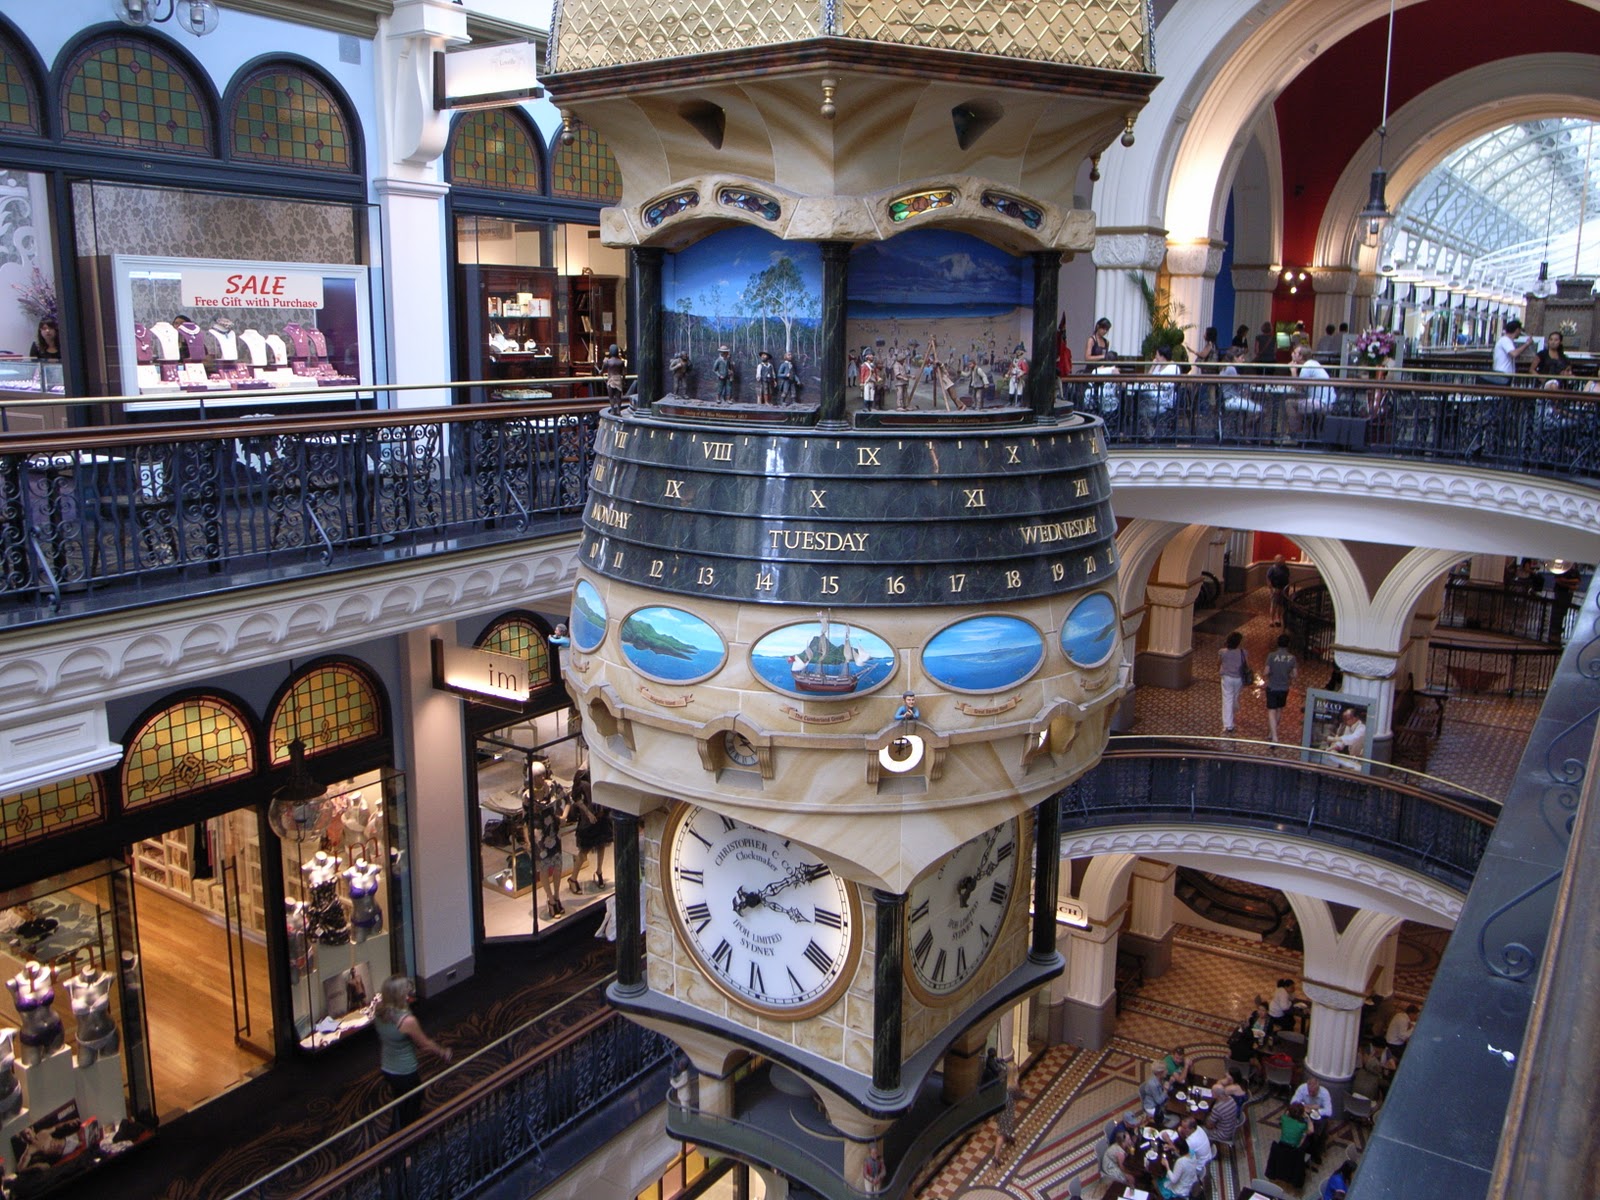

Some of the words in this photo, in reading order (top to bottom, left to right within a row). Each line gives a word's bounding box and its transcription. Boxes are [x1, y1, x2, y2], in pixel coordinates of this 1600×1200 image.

[225, 274, 287, 295] SALE
[194, 296, 218, 307] Free
[221, 296, 242, 307] Gift
[245, 297, 270, 308] with
[273, 298, 318, 309] Purchase
[614, 431, 628, 449] VII
[702, 441, 734, 461] VIII
[857, 447, 881, 466] IX
[1006, 445, 1021, 464] X
[664, 479, 685, 499] IX
[810, 489, 826, 509] X
[963, 488, 986, 508] XI
[1073, 478, 1090, 497] XII
[591, 503, 632, 530] MONDAY
[769, 530, 869, 552] TUESDAY
[1019, 516, 1098, 545] WEDNESDAY
[613, 551, 624, 568] 11
[650, 559, 664, 578] 12
[697, 566, 714, 585] 13
[755, 572, 773, 591] 14
[820, 575, 839, 594] 15
[887, 575, 905, 594] 16
[949, 573, 966, 593] 17
[1005, 570, 1022, 589] 18
[1051, 563, 1065, 582] 19
[1084, 555, 1096, 575] 20
[488, 663, 517, 691] im
[715, 838, 768, 867] CHRISTOPHER
[771, 850, 779, 859] C
[735, 851, 778, 872] Clockmaker
[680, 865, 704, 887] IX
[686, 900, 712, 934] VIII
[733, 919, 750, 937] IPOH
[752, 933, 782, 944] LIMITED
[814, 904, 841, 931] III
[951, 922, 974, 941] SYDNEY
[712, 936, 733, 974] VII
[740, 938, 774, 956] SYDNEY
[802, 938, 832, 976] IIII
[750, 960, 765, 995] VI
[786, 965, 806, 995] V
